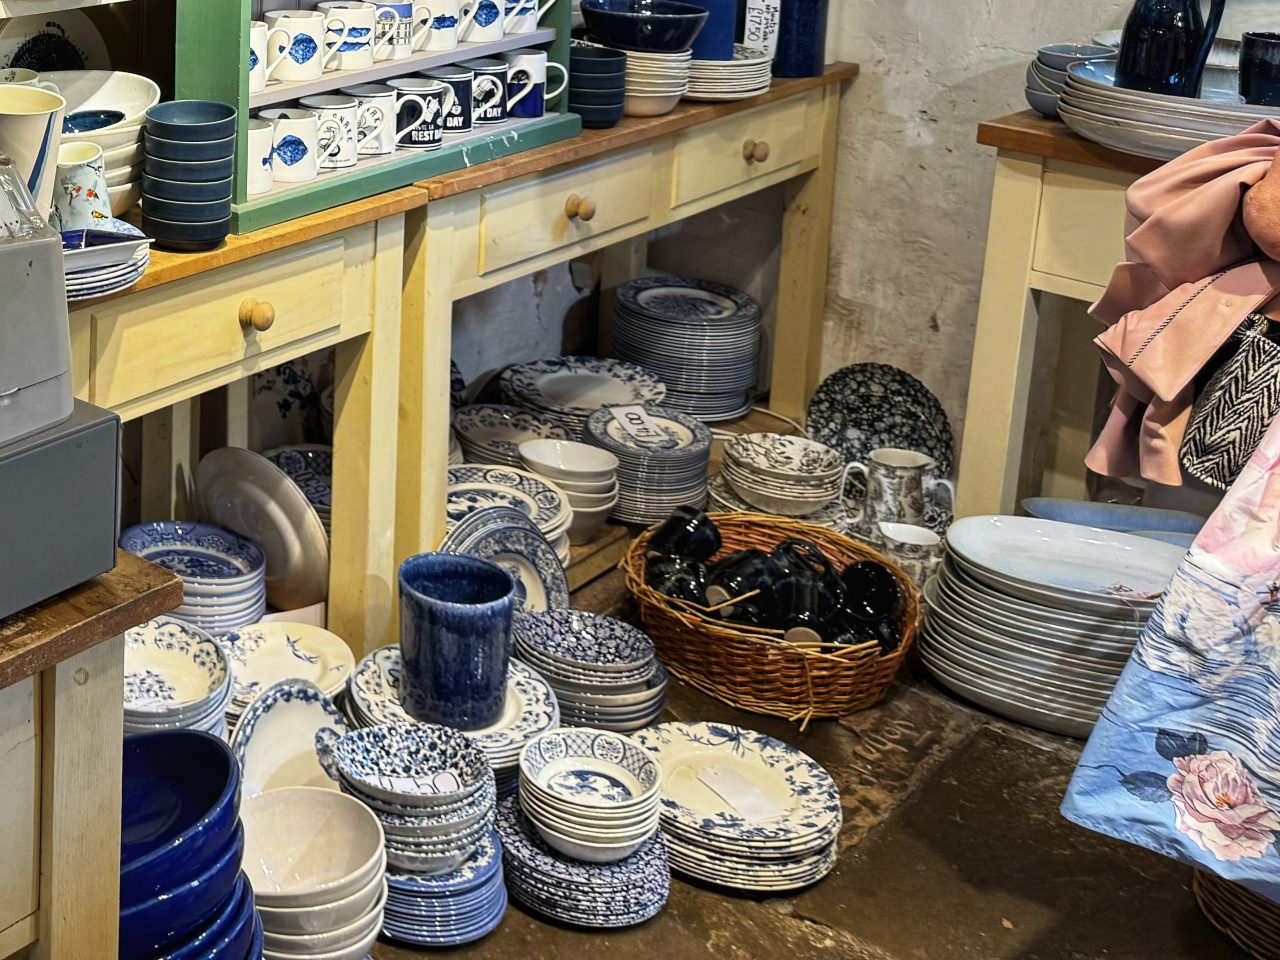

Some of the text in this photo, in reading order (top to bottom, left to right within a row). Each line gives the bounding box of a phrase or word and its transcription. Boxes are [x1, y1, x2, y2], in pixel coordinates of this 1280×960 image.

[487, 107, 503, 118] DAY
[446, 116, 464, 127] DAY
[411, 130, 434, 142] REST
